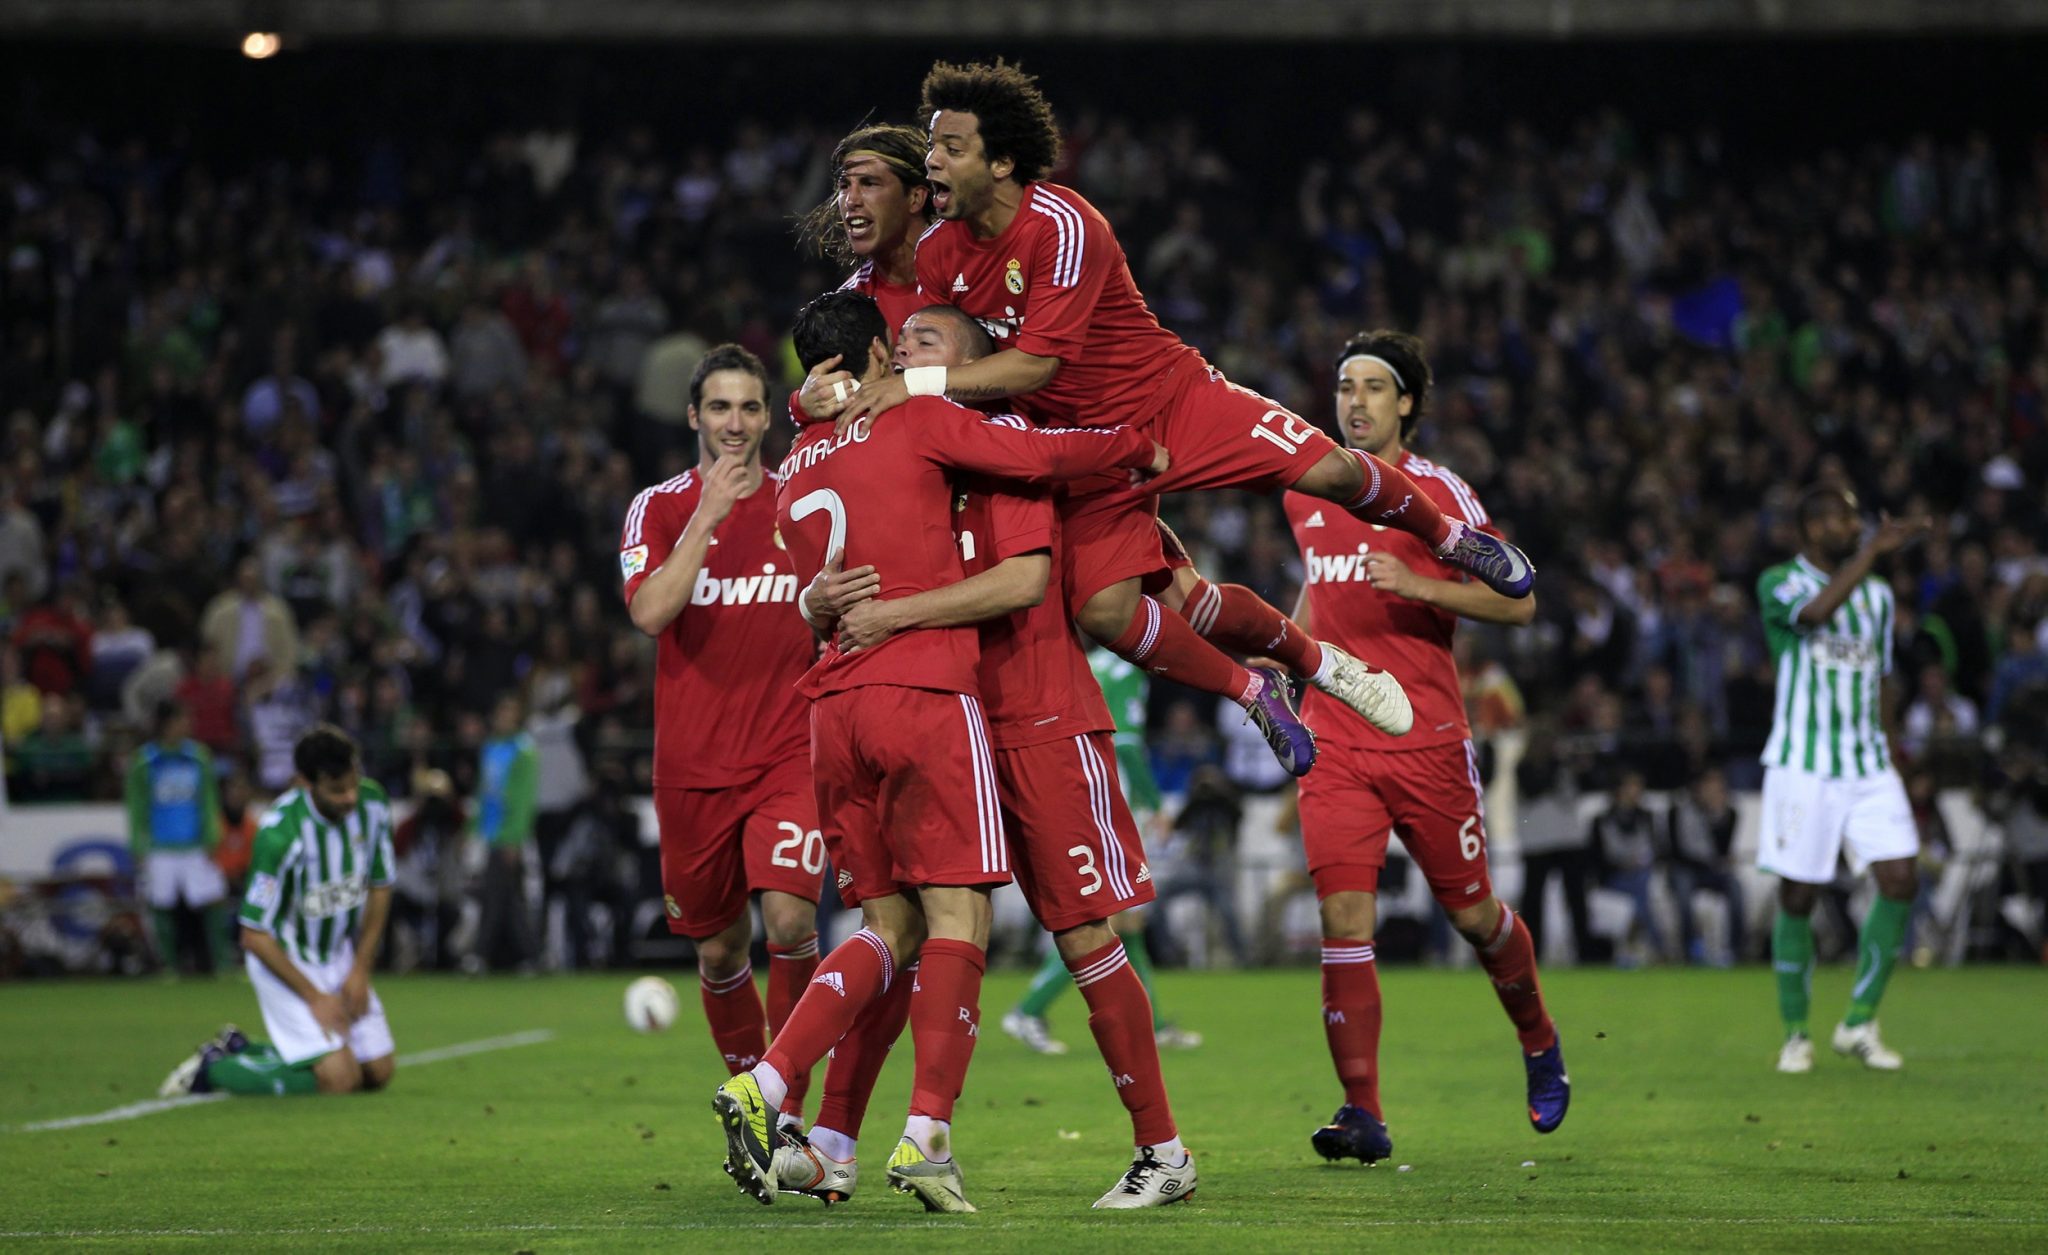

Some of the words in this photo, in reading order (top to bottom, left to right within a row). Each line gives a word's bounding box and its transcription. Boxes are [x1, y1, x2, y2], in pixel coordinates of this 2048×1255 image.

[1250, 409, 1315, 455] 12
[790, 487, 847, 577] 7
[690, 562, 799, 606] bwin
[1305, 542, 1373, 585] bwi
[771, 820, 827, 875] 20
[1458, 815, 1481, 861] 6
[1068, 844, 1103, 896] 3
